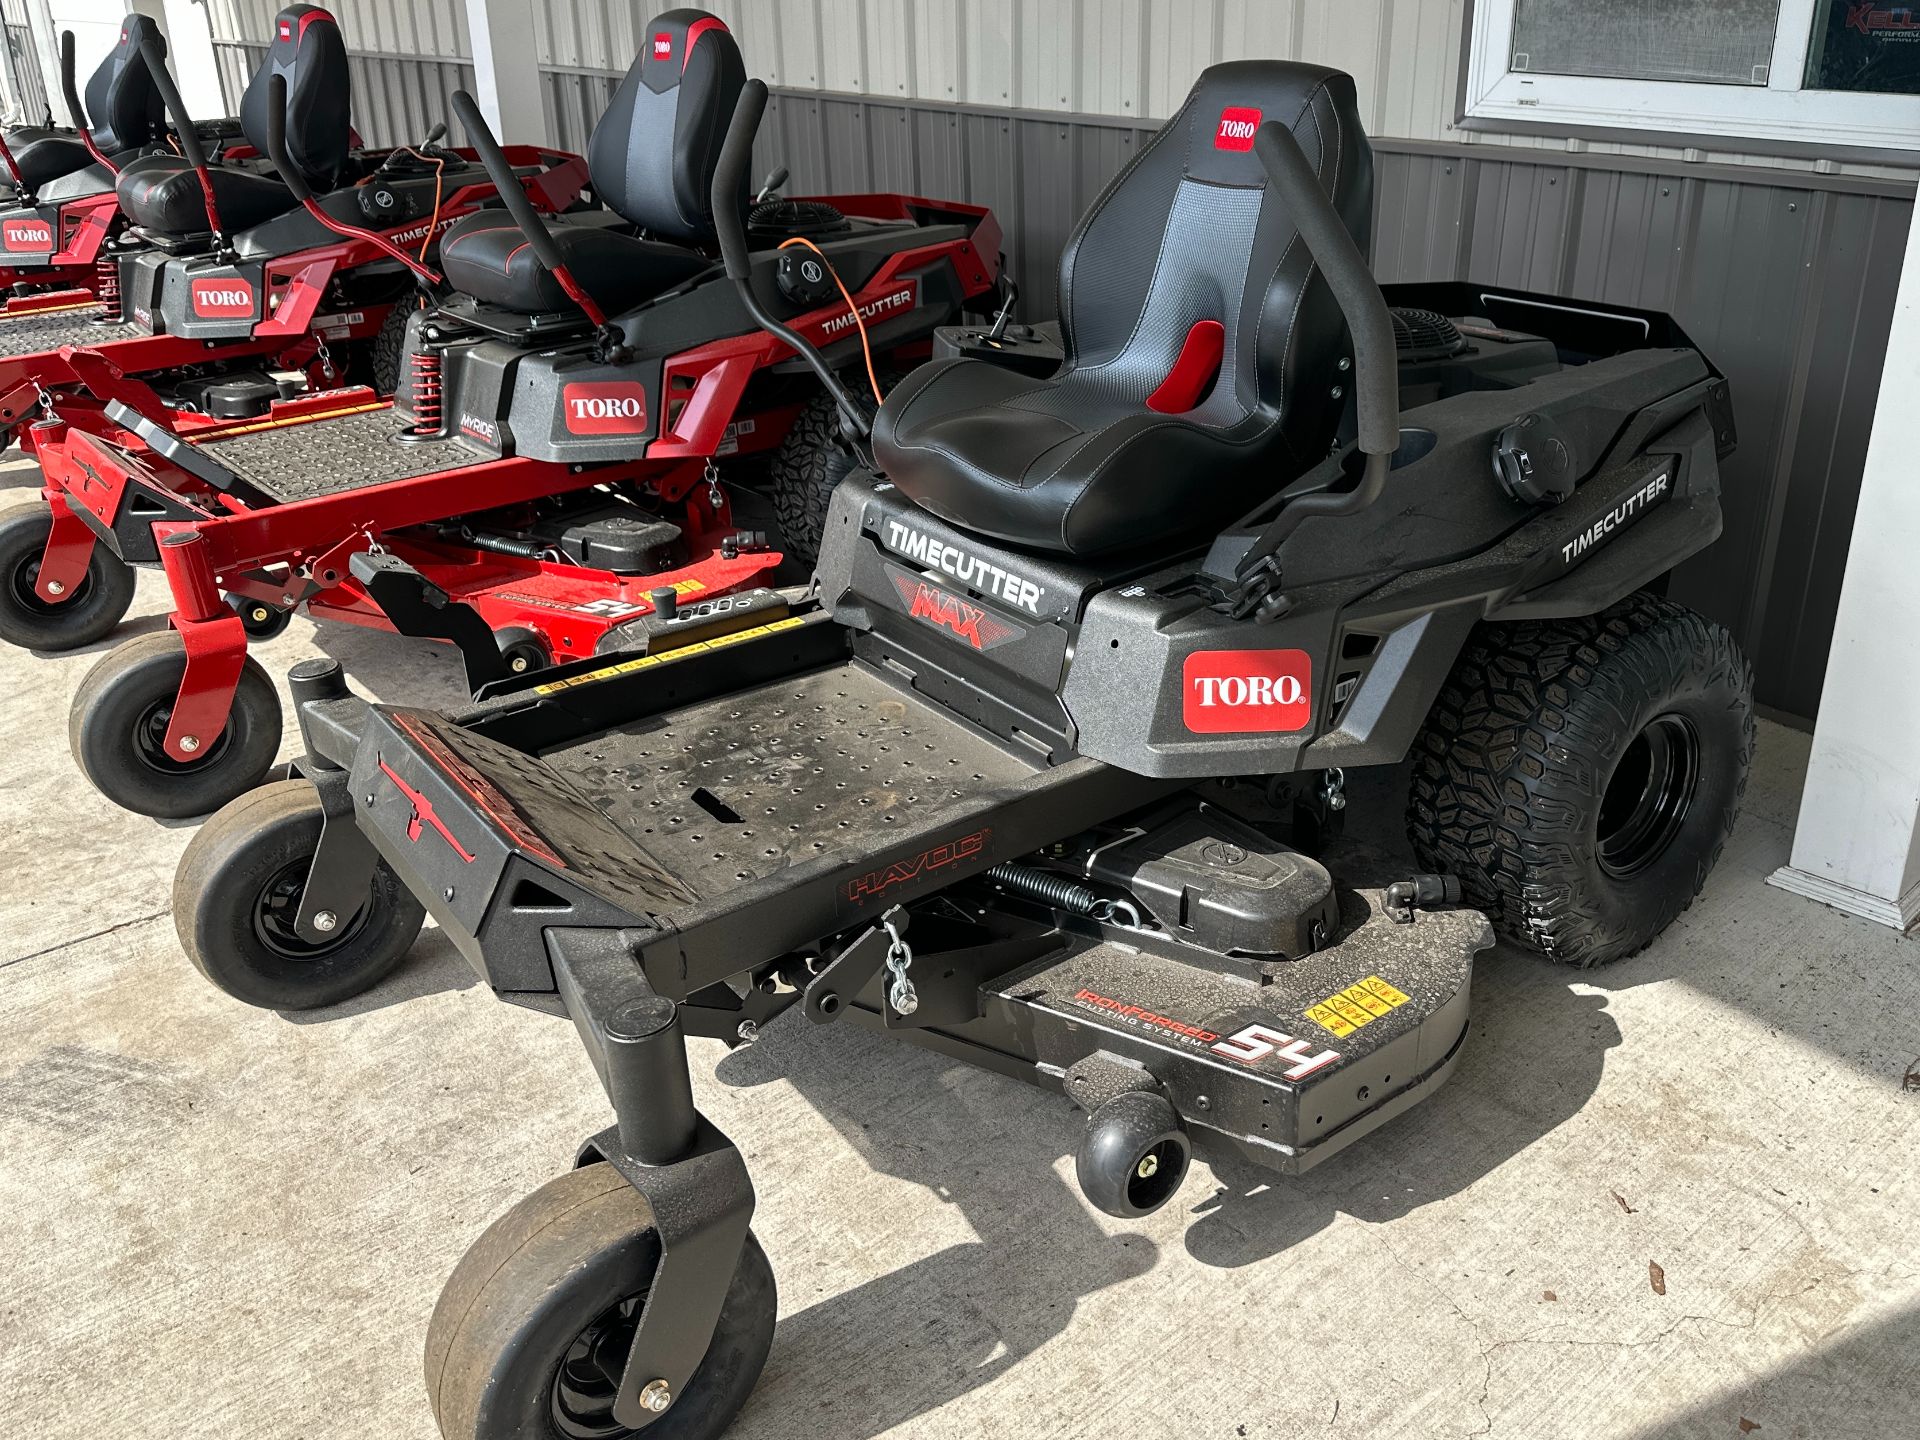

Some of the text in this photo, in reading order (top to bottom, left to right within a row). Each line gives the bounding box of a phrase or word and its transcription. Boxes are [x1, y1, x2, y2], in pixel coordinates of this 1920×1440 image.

[1845, 2, 1920, 35] KELL
[1872, 30, 1920, 38] PERFORM
[1220, 120, 1255, 139] TORO
[7, 229, 49, 242] TORO
[391, 215, 466, 245] TIMECUTT
[197, 290, 250, 306] TORO
[570, 397, 640, 419] TORO
[1562, 473, 1668, 564] TIMECUTTER
[889, 520, 1040, 614] TIMECUTTER
[910, 582, 986, 650] MAX
[1194, 675, 1302, 706] TORO
[849, 832, 983, 900] HAVOC
[1076, 1001, 1203, 1047] CUTTING SYSTEM
[1211, 1023, 1341, 1081] 54
